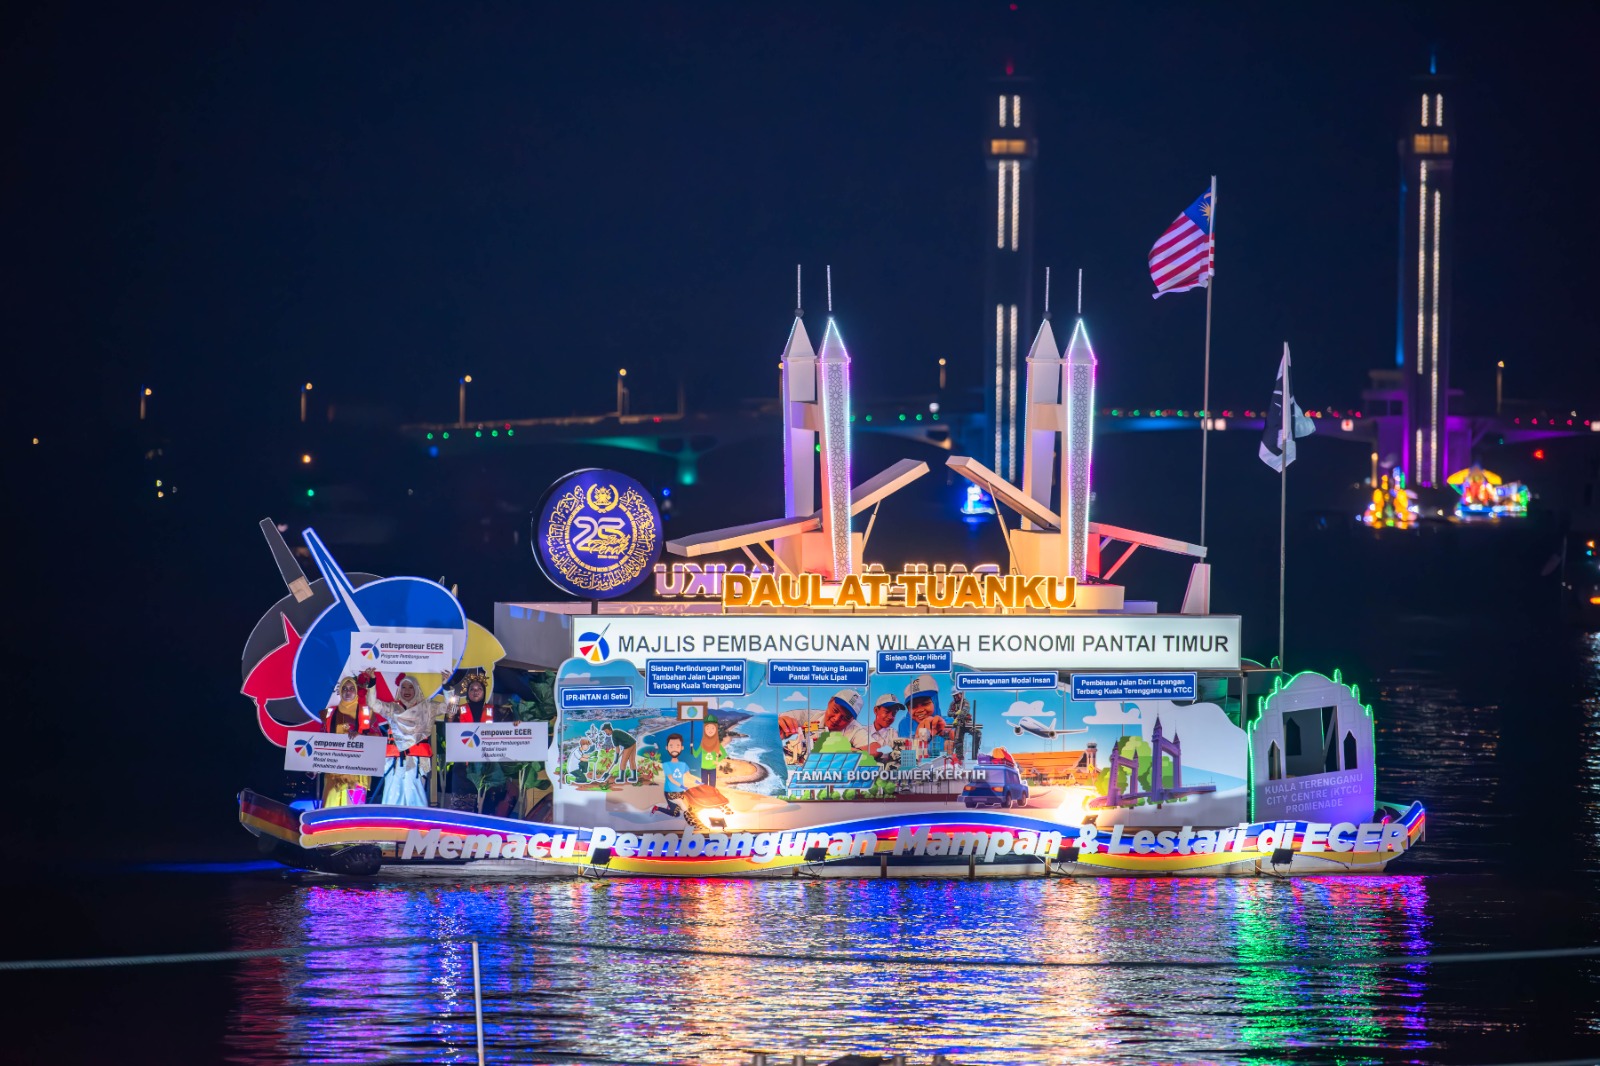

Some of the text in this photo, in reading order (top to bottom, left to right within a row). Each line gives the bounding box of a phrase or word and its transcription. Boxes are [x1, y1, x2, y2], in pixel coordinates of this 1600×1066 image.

[573, 516, 626, 551] 25
[724, 573, 1077, 609] DAULAT TUANKU
[380, 642, 444, 651] entrepreneur ECER
[618, 634, 1229, 653] MAJLIS PEMBANGUNAN WILAYAH EKONOMI PANTAI TIMUR
[650, 664, 742, 673] Sistem Perlindungan Pantai
[773, 664, 864, 674] Pembinaan Tanjung Buatan
[915, 662, 936, 670] Kapas
[652, 673, 740, 682] Tambahan Jalan Lapangan
[788, 673, 848, 682] Pantai Teluk Lipat
[962, 677, 1010, 685] Pembangunan
[1152, 678, 1186, 686] Lapangan
[653, 682, 680, 690] Terbang
[702, 682, 741, 690] Terengganu
[610, 692, 628, 700] Setiu
[1076, 688, 1103, 696] Terbang
[1124, 687, 1163, 695] Terengganu
[481, 728, 532, 737] empower ECER
[314, 740, 364, 749] empower ECER
[795, 769, 986, 781] TAMAN BIOPOLIMER KERTIH
[1264, 773, 1363, 795] KUALA TERENGGANU
[1266, 784, 1362, 806] CITY CENTRE (KTCC)
[1285, 798, 1344, 813] PROMENADE
[401, 822, 1408, 863] Memacu Pembangunan Mampan & Lestari di ECER
